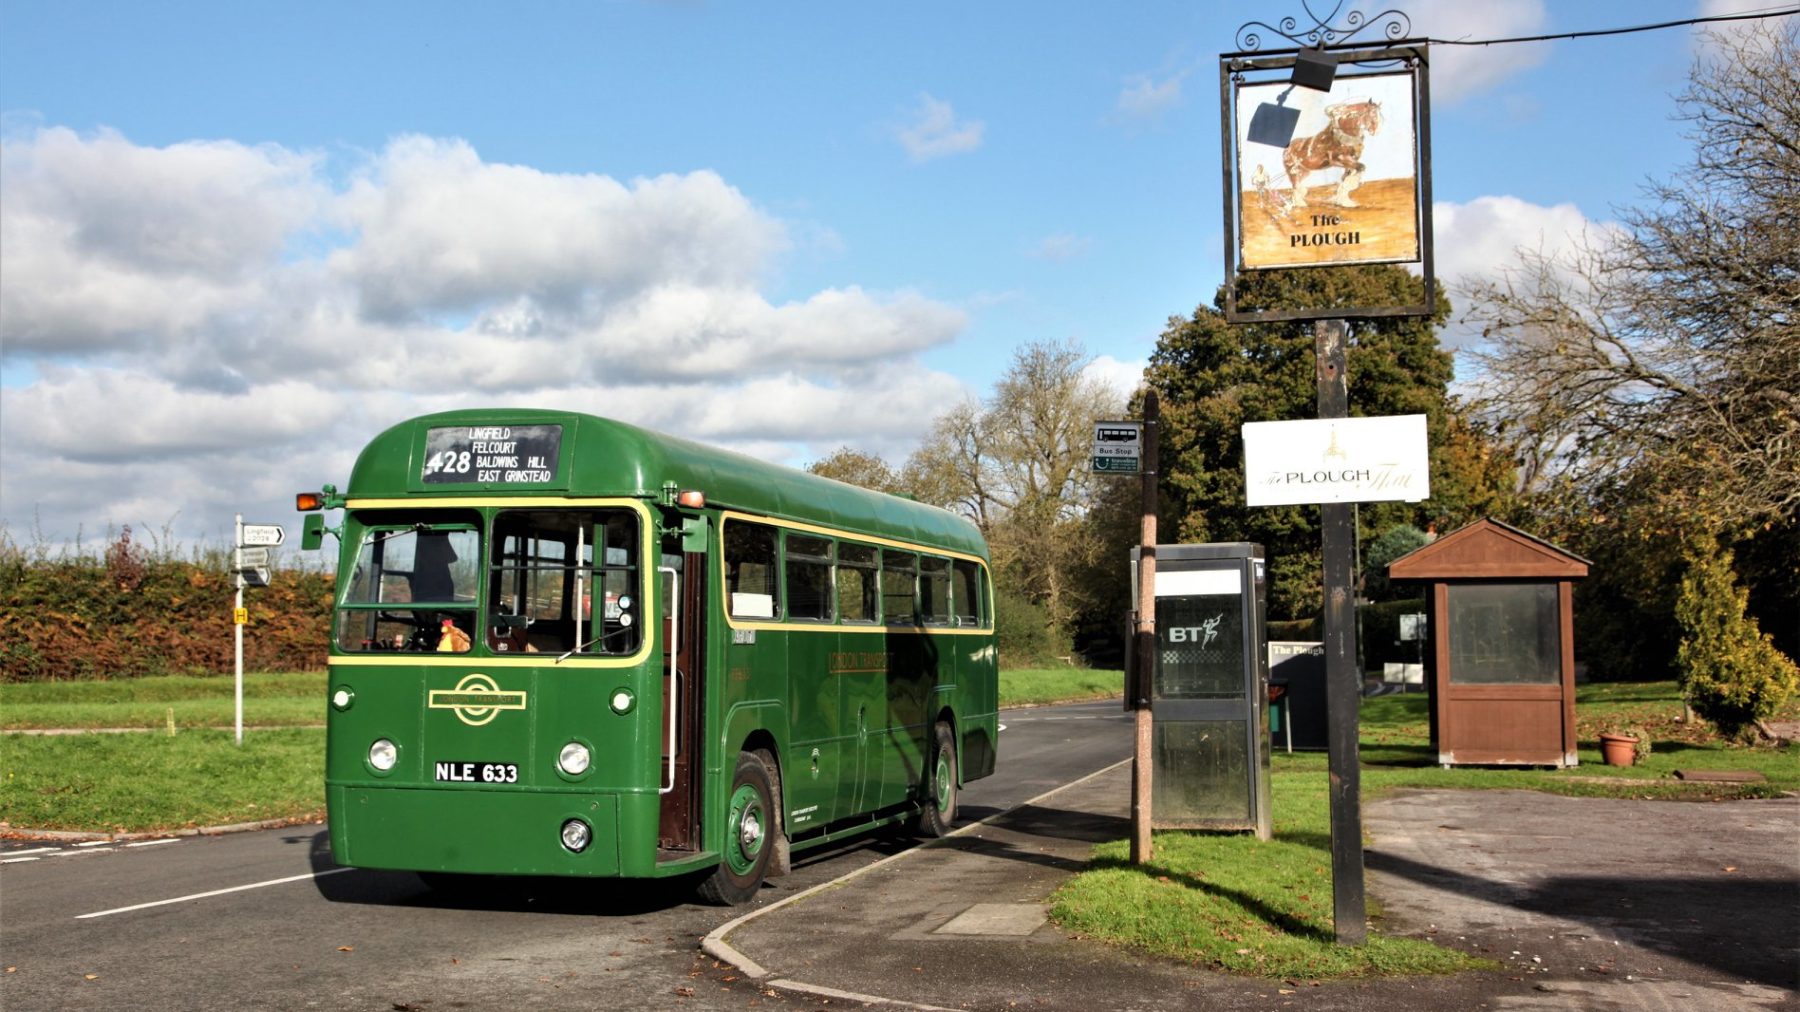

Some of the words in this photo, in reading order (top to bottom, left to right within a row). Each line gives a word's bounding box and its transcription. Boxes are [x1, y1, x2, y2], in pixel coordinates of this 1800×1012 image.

[1310, 214, 1340, 227] The
[1290, 231, 1360, 247] PLOUGH
[469, 427, 511, 440] LINGFIELD
[472, 441, 517, 454] FELCOURT
[426, 451, 471, 473] 428
[476, 456, 518, 468] BALDWINS
[528, 456, 547, 469] HILL
[477, 470, 501, 482] EAST
[505, 470, 551, 483] GRINSTEAD
[1285, 468, 1370, 484] PLOUGH
[1168, 626, 1203, 643] BT
[1272, 645, 1291, 655] The
[1293, 645, 1325, 657] Plough
[436, 763, 475, 781] NLE
[482, 764, 518, 783] 633
